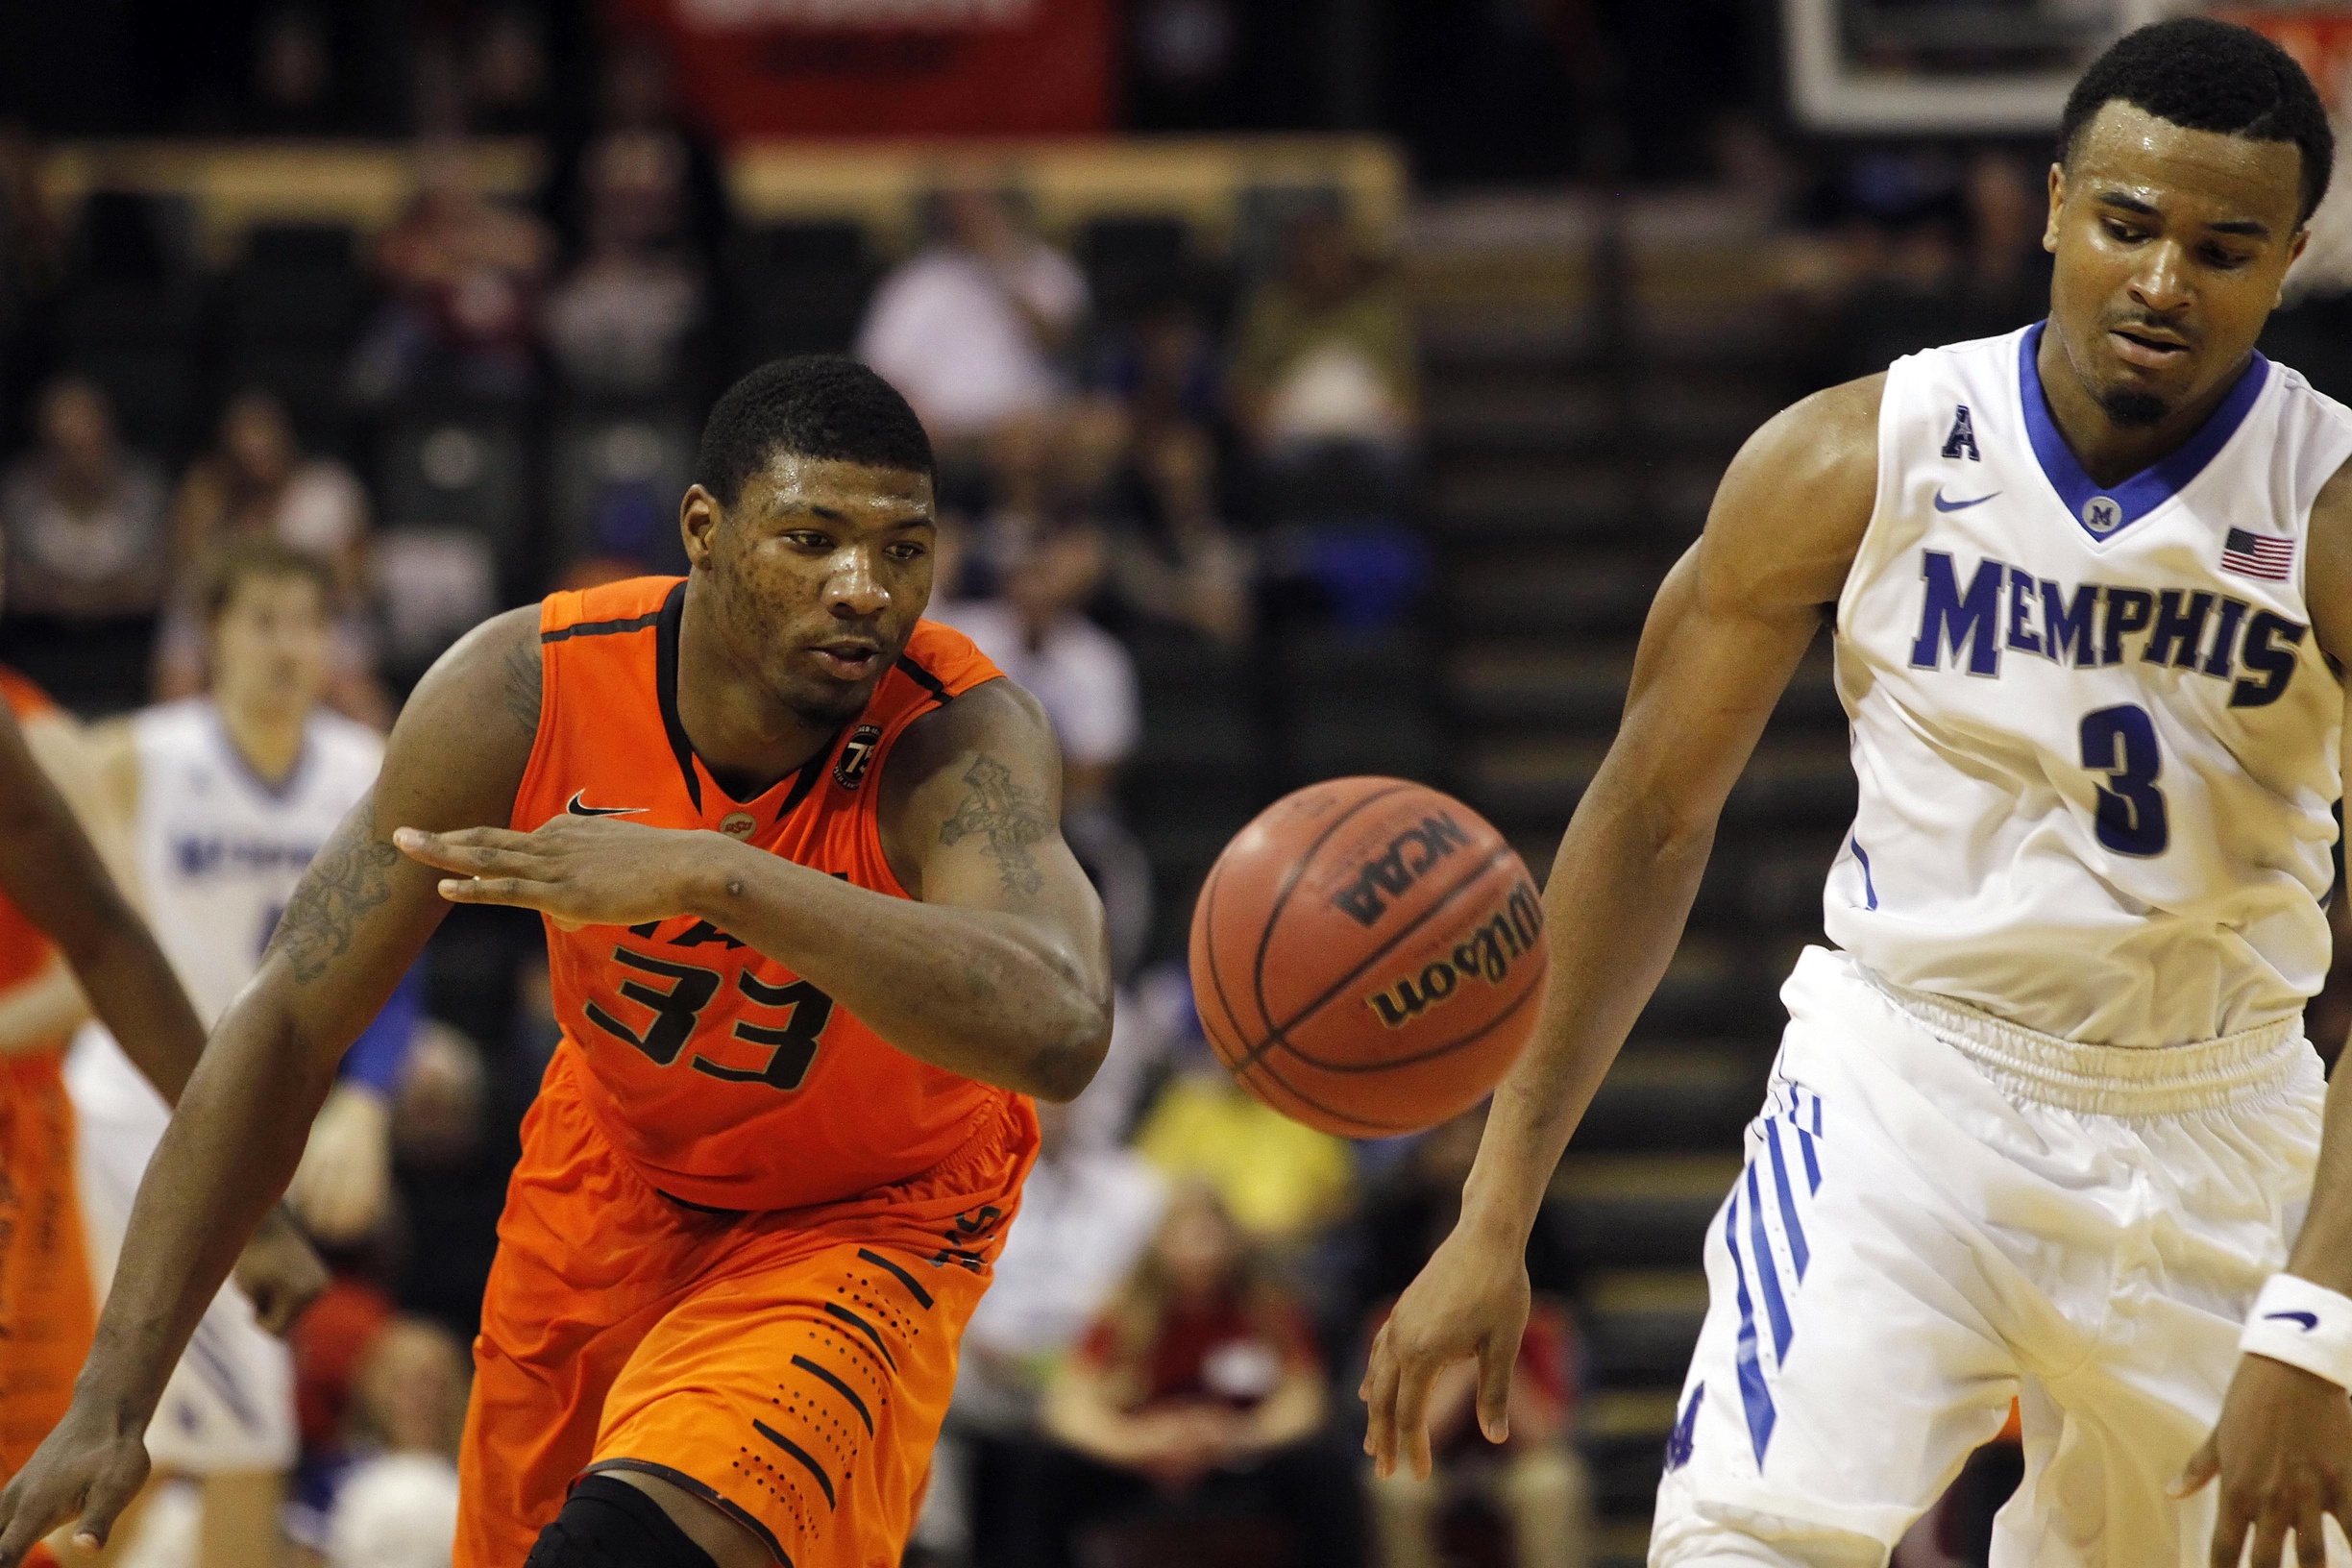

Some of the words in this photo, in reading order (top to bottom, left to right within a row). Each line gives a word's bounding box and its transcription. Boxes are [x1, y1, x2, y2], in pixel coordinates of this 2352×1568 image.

[1941, 404, 1981, 462] A
[2090, 504, 2114, 527] M
[1908, 548, 2310, 709] MEMPHIS
[2078, 702, 2169, 858] 3
[1333, 809, 1471, 929] NCAA
[584, 944, 835, 1091] 33
[1364, 880, 1544, 1029] Wilson
